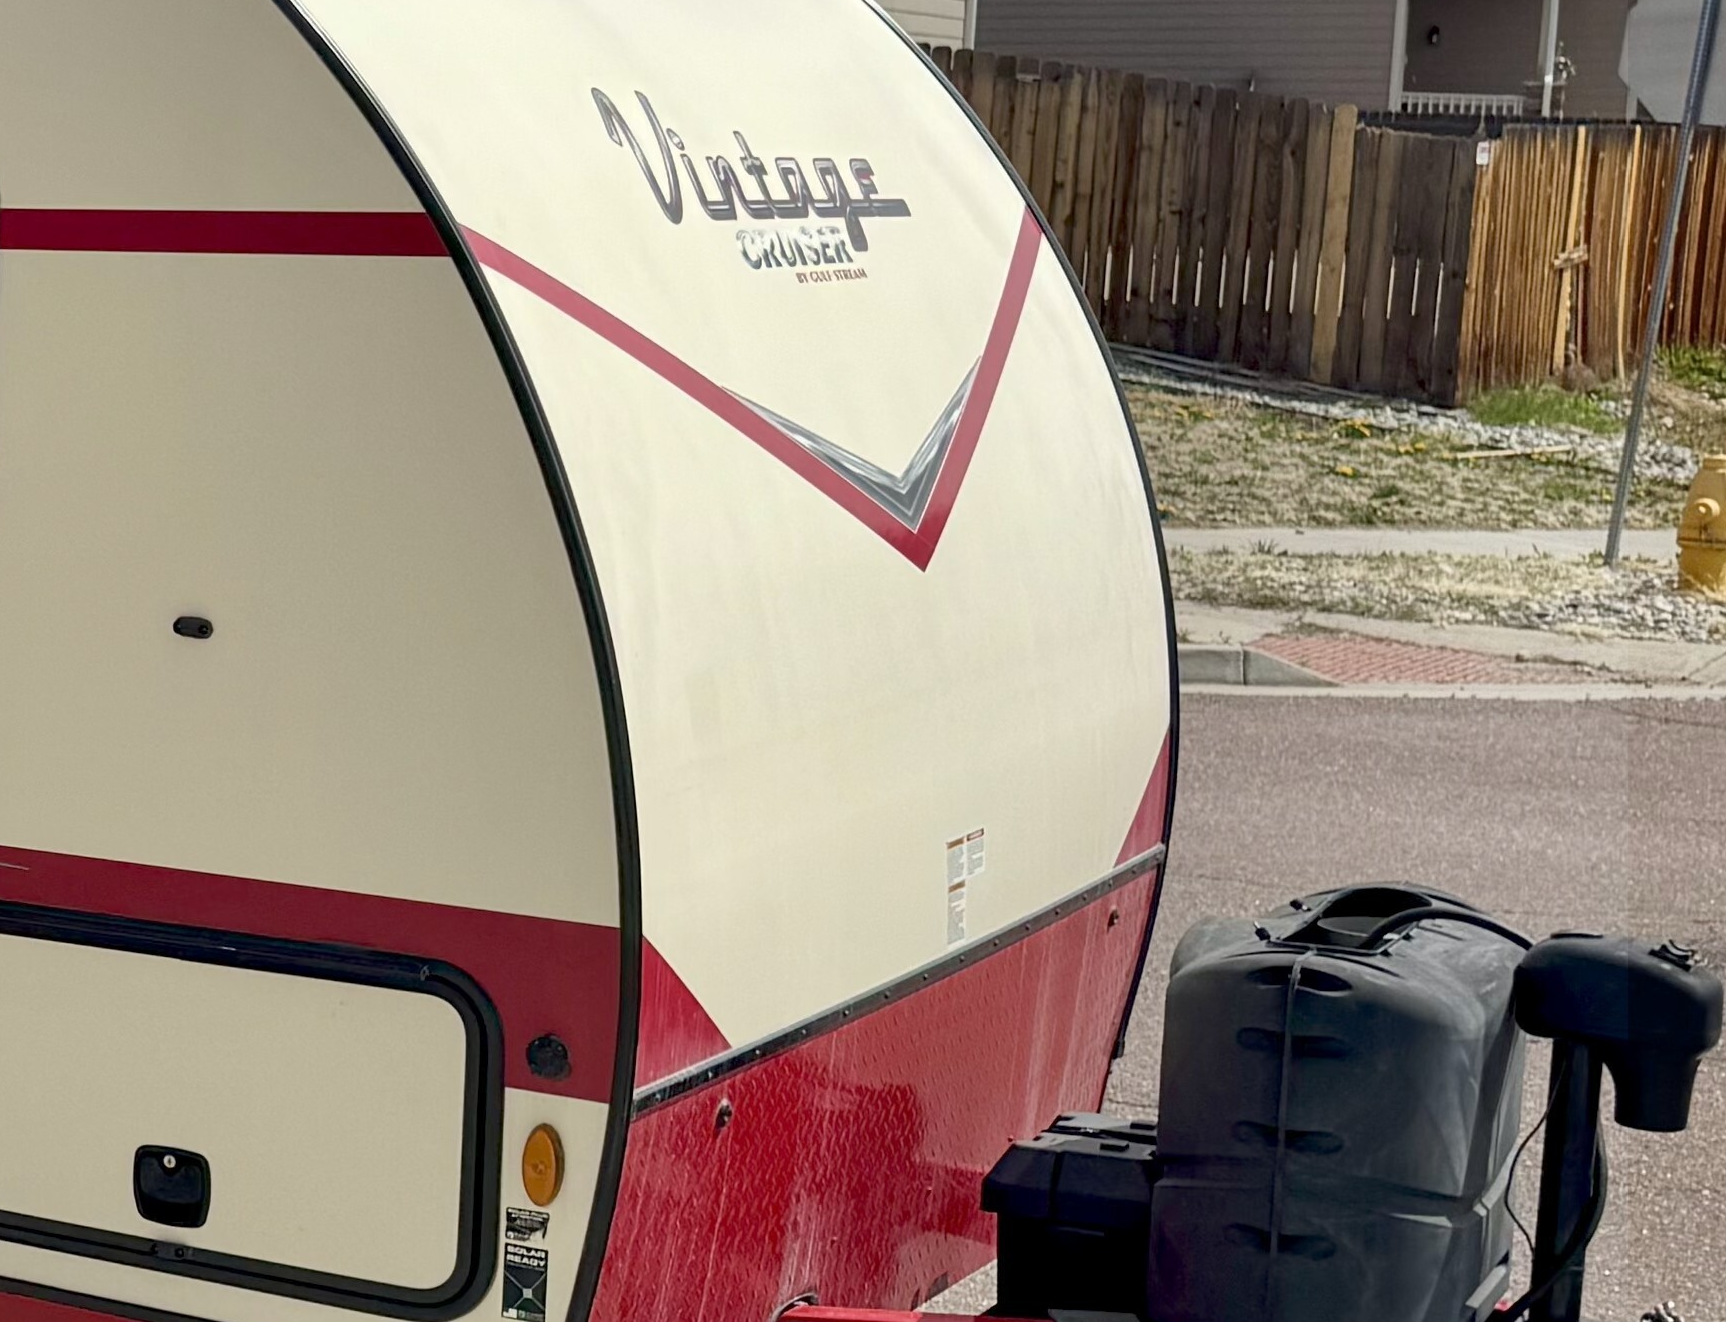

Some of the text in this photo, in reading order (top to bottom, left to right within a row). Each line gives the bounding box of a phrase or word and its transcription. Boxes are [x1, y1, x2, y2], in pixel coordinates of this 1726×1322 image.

[591, 87, 911, 252] Vintage
[736, 226, 853, 269] CRUISER
[796, 272, 809, 284] BY
